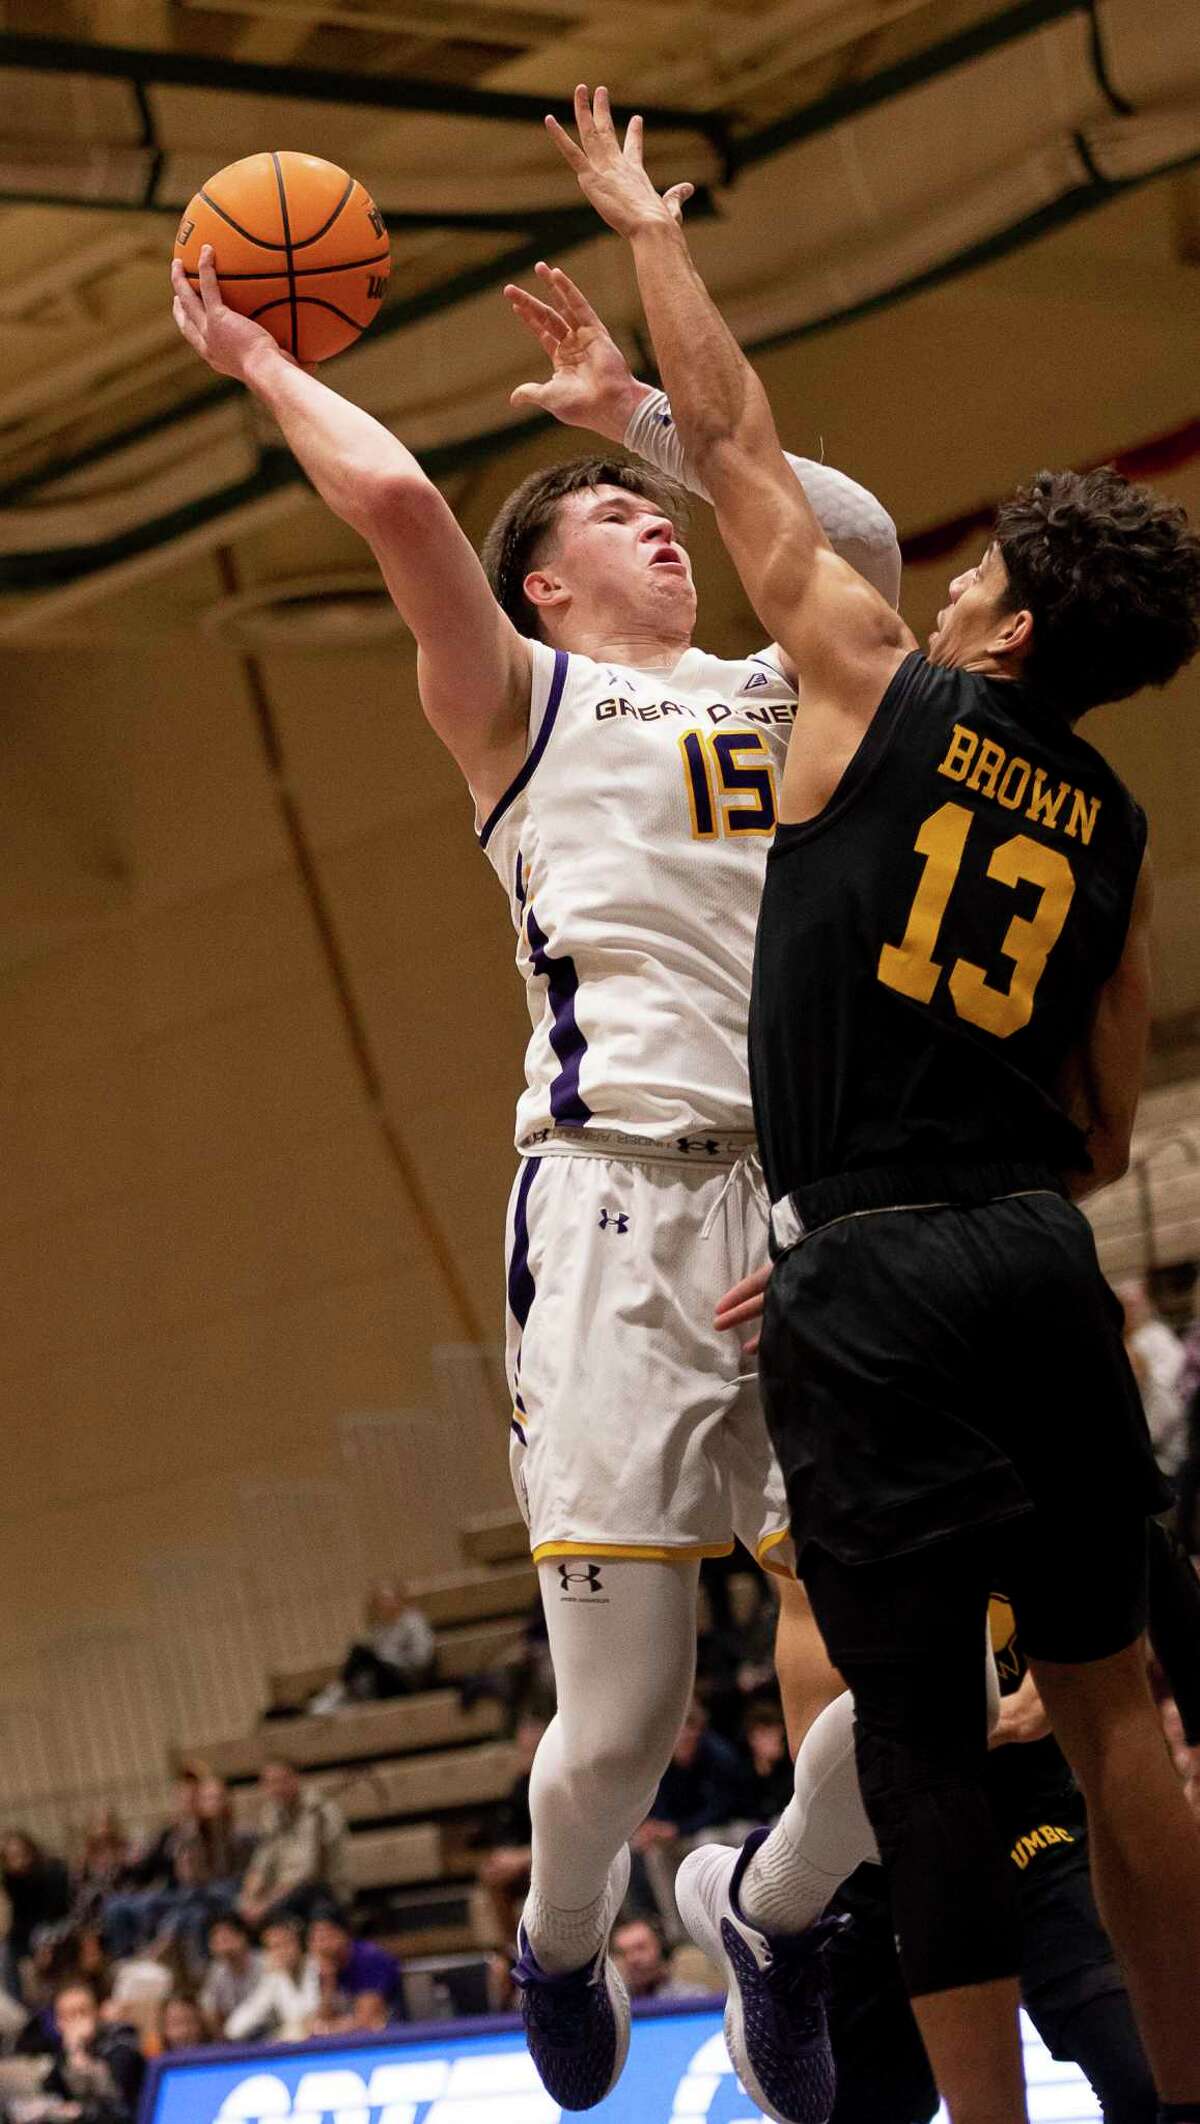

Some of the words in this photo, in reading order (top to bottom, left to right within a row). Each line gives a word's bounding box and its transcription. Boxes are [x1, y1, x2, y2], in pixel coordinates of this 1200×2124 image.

[677, 727, 779, 841] 15
[937, 723, 1102, 847] BROWN
[877, 801, 1077, 1039] 13
[1010, 1823, 1076, 1871] UMBC
